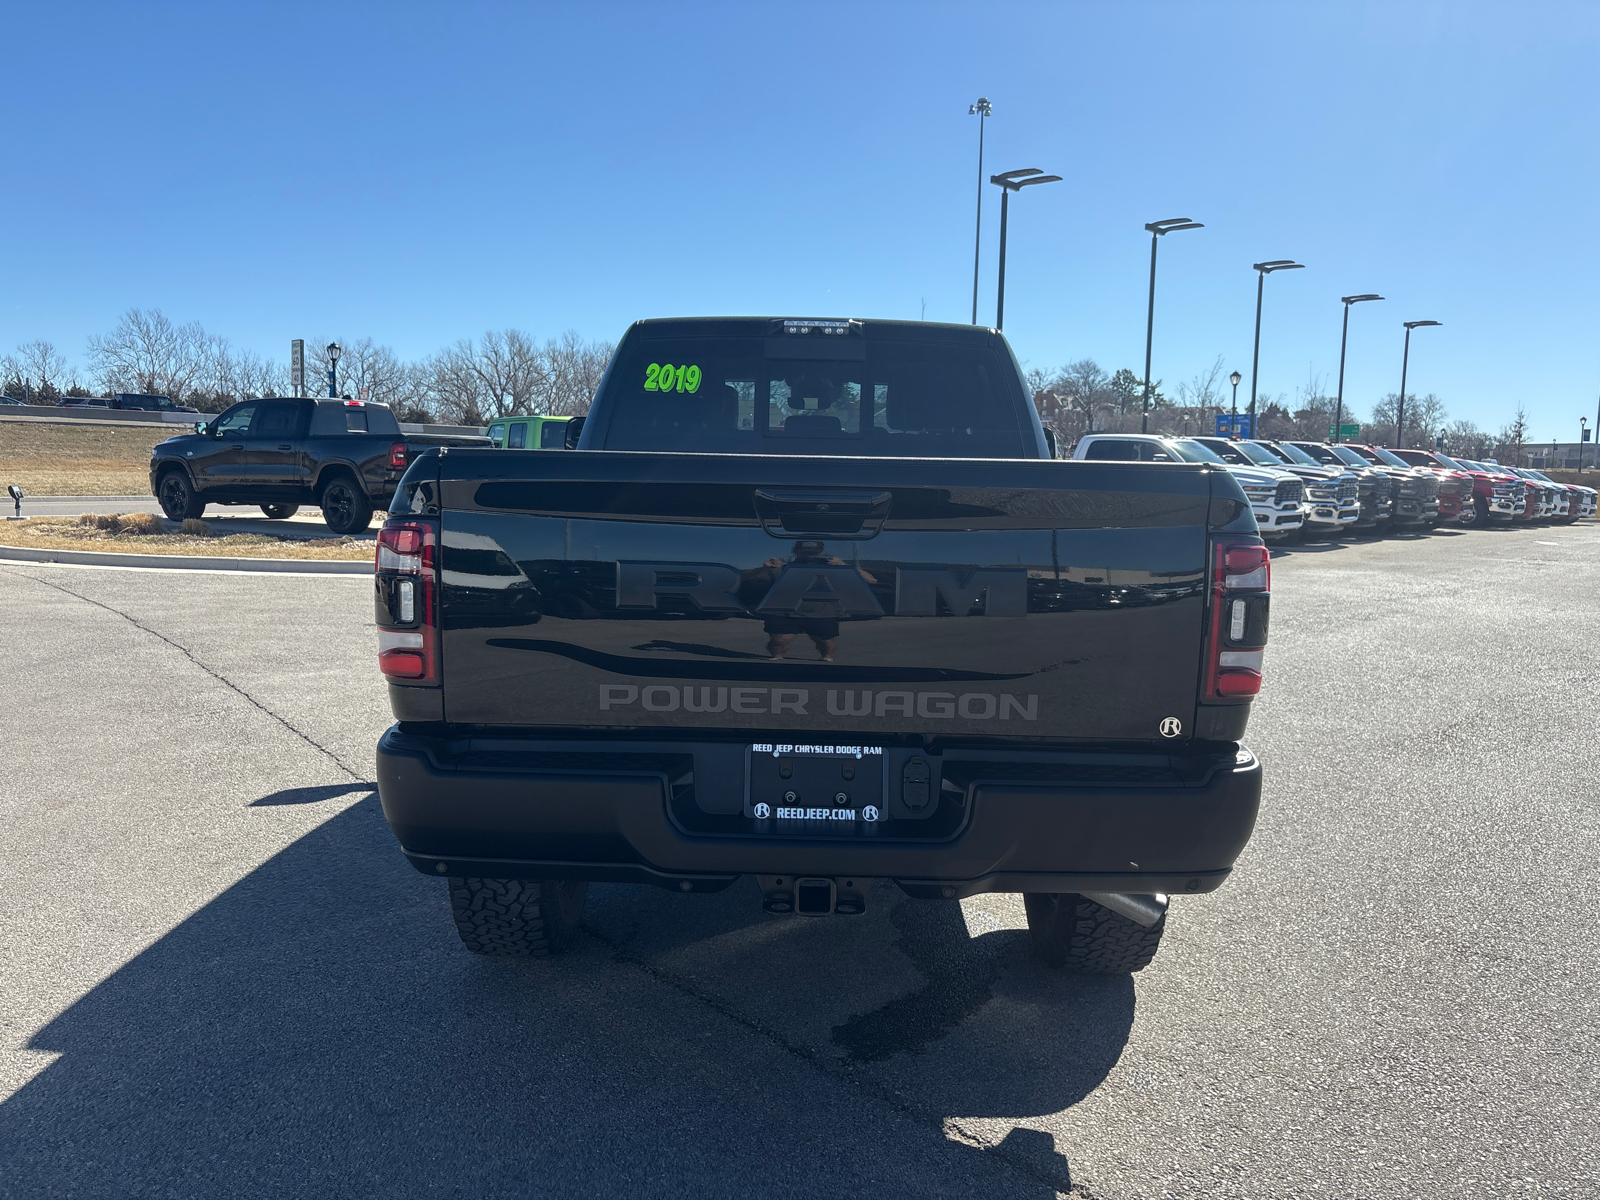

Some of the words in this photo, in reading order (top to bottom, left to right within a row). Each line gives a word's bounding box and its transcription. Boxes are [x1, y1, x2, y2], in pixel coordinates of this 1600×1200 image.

[644, 363, 702, 394] 2019
[616, 559, 1028, 618] RAM
[599, 684, 808, 715] POWER
[826, 689, 1039, 721] WAGON
[752, 743, 773, 752] REED
[775, 744, 793, 753] JEEP
[795, 744, 834, 754] CHRYSLER
[836, 745, 862, 755] DODGE
[863, 746, 882, 755] RAM
[776, 807, 856, 820] REEDJEEP.COM
